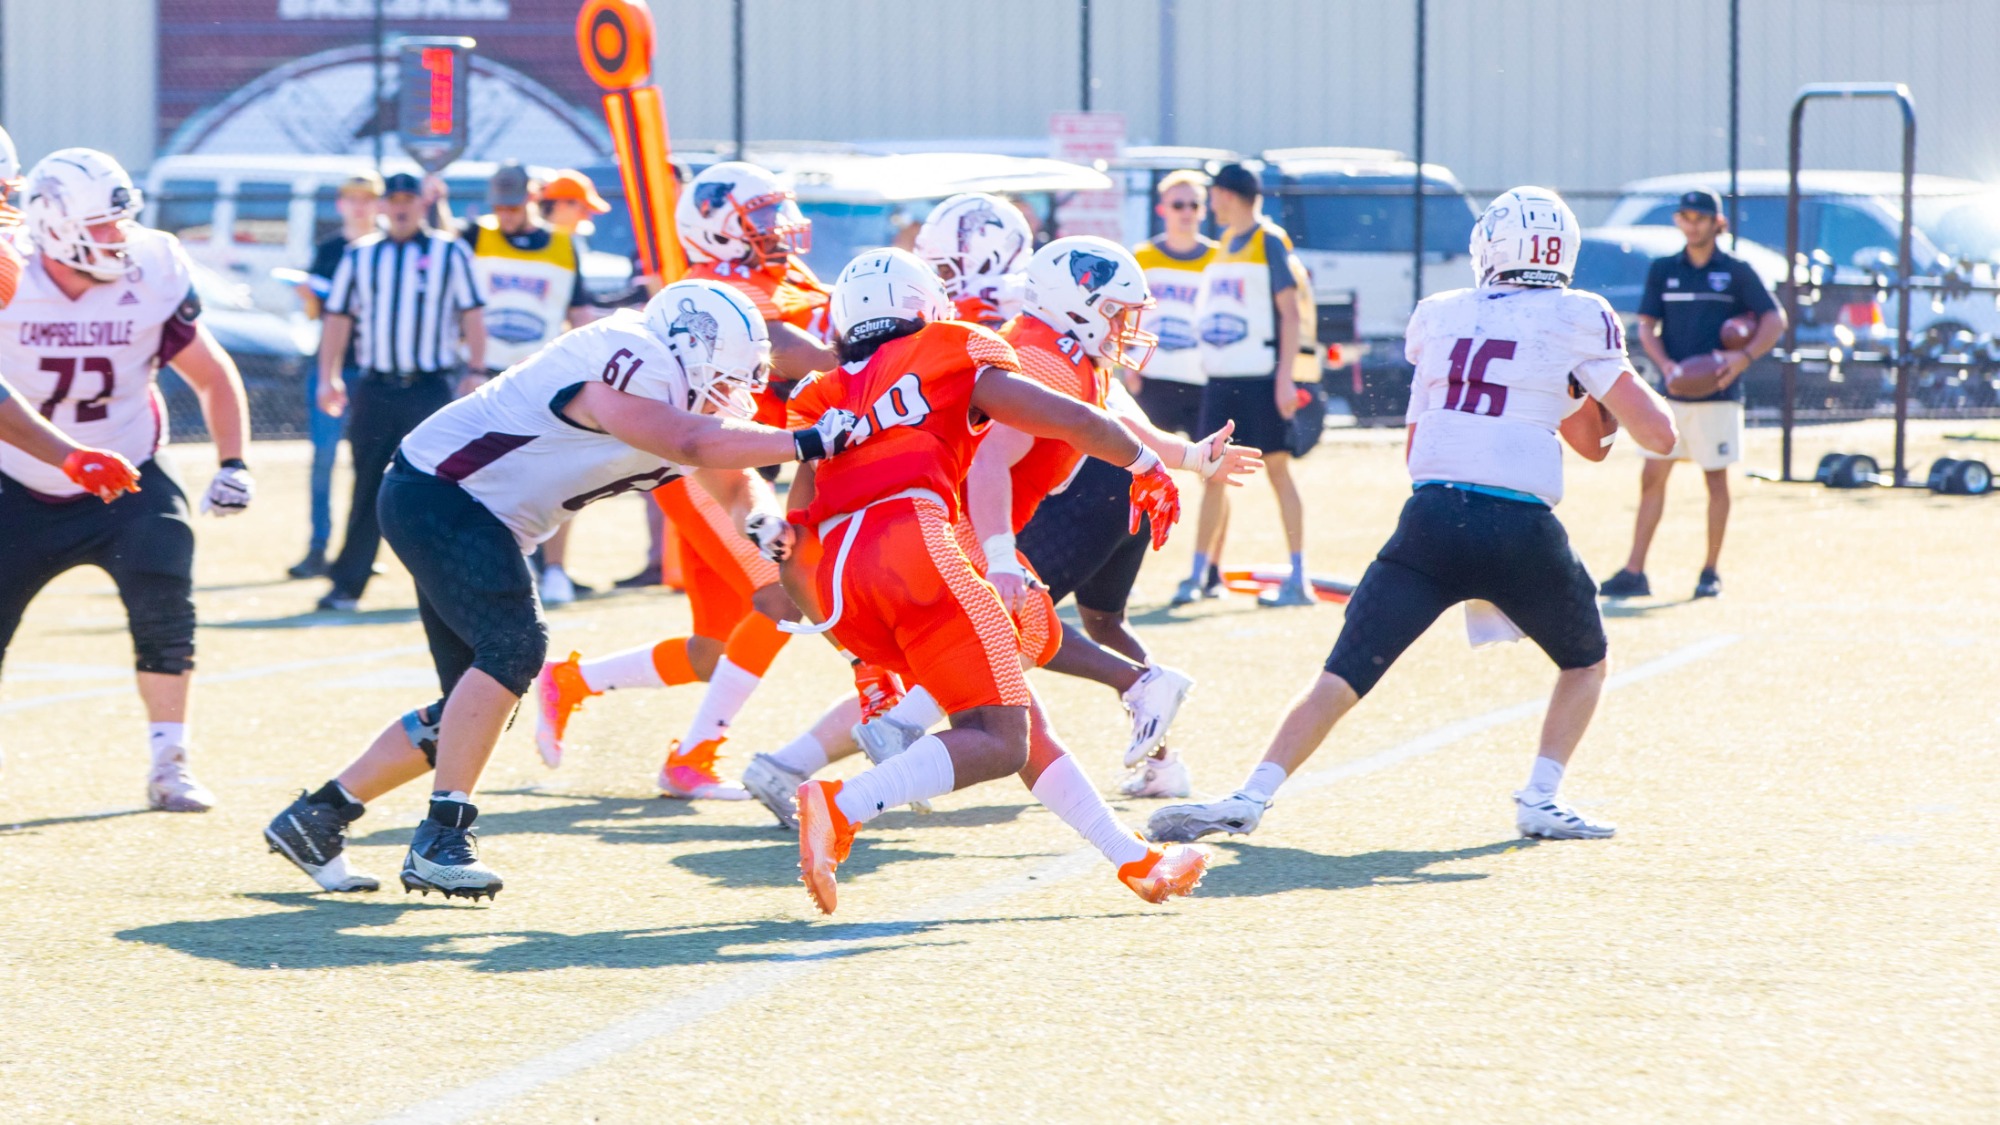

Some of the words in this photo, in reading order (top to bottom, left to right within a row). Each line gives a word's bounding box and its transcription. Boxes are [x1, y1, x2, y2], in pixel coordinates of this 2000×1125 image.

[422, 47, 453, 134] 1
[20, 321, 134, 347] CAMPBELLSVILLE
[853, 318, 891, 336] schutt
[1055, 336, 1085, 367] 41
[38, 357, 115, 424] 72
[602, 347, 644, 392] 61
[1443, 337, 1518, 417] 16
[845, 372, 932, 447] 0
